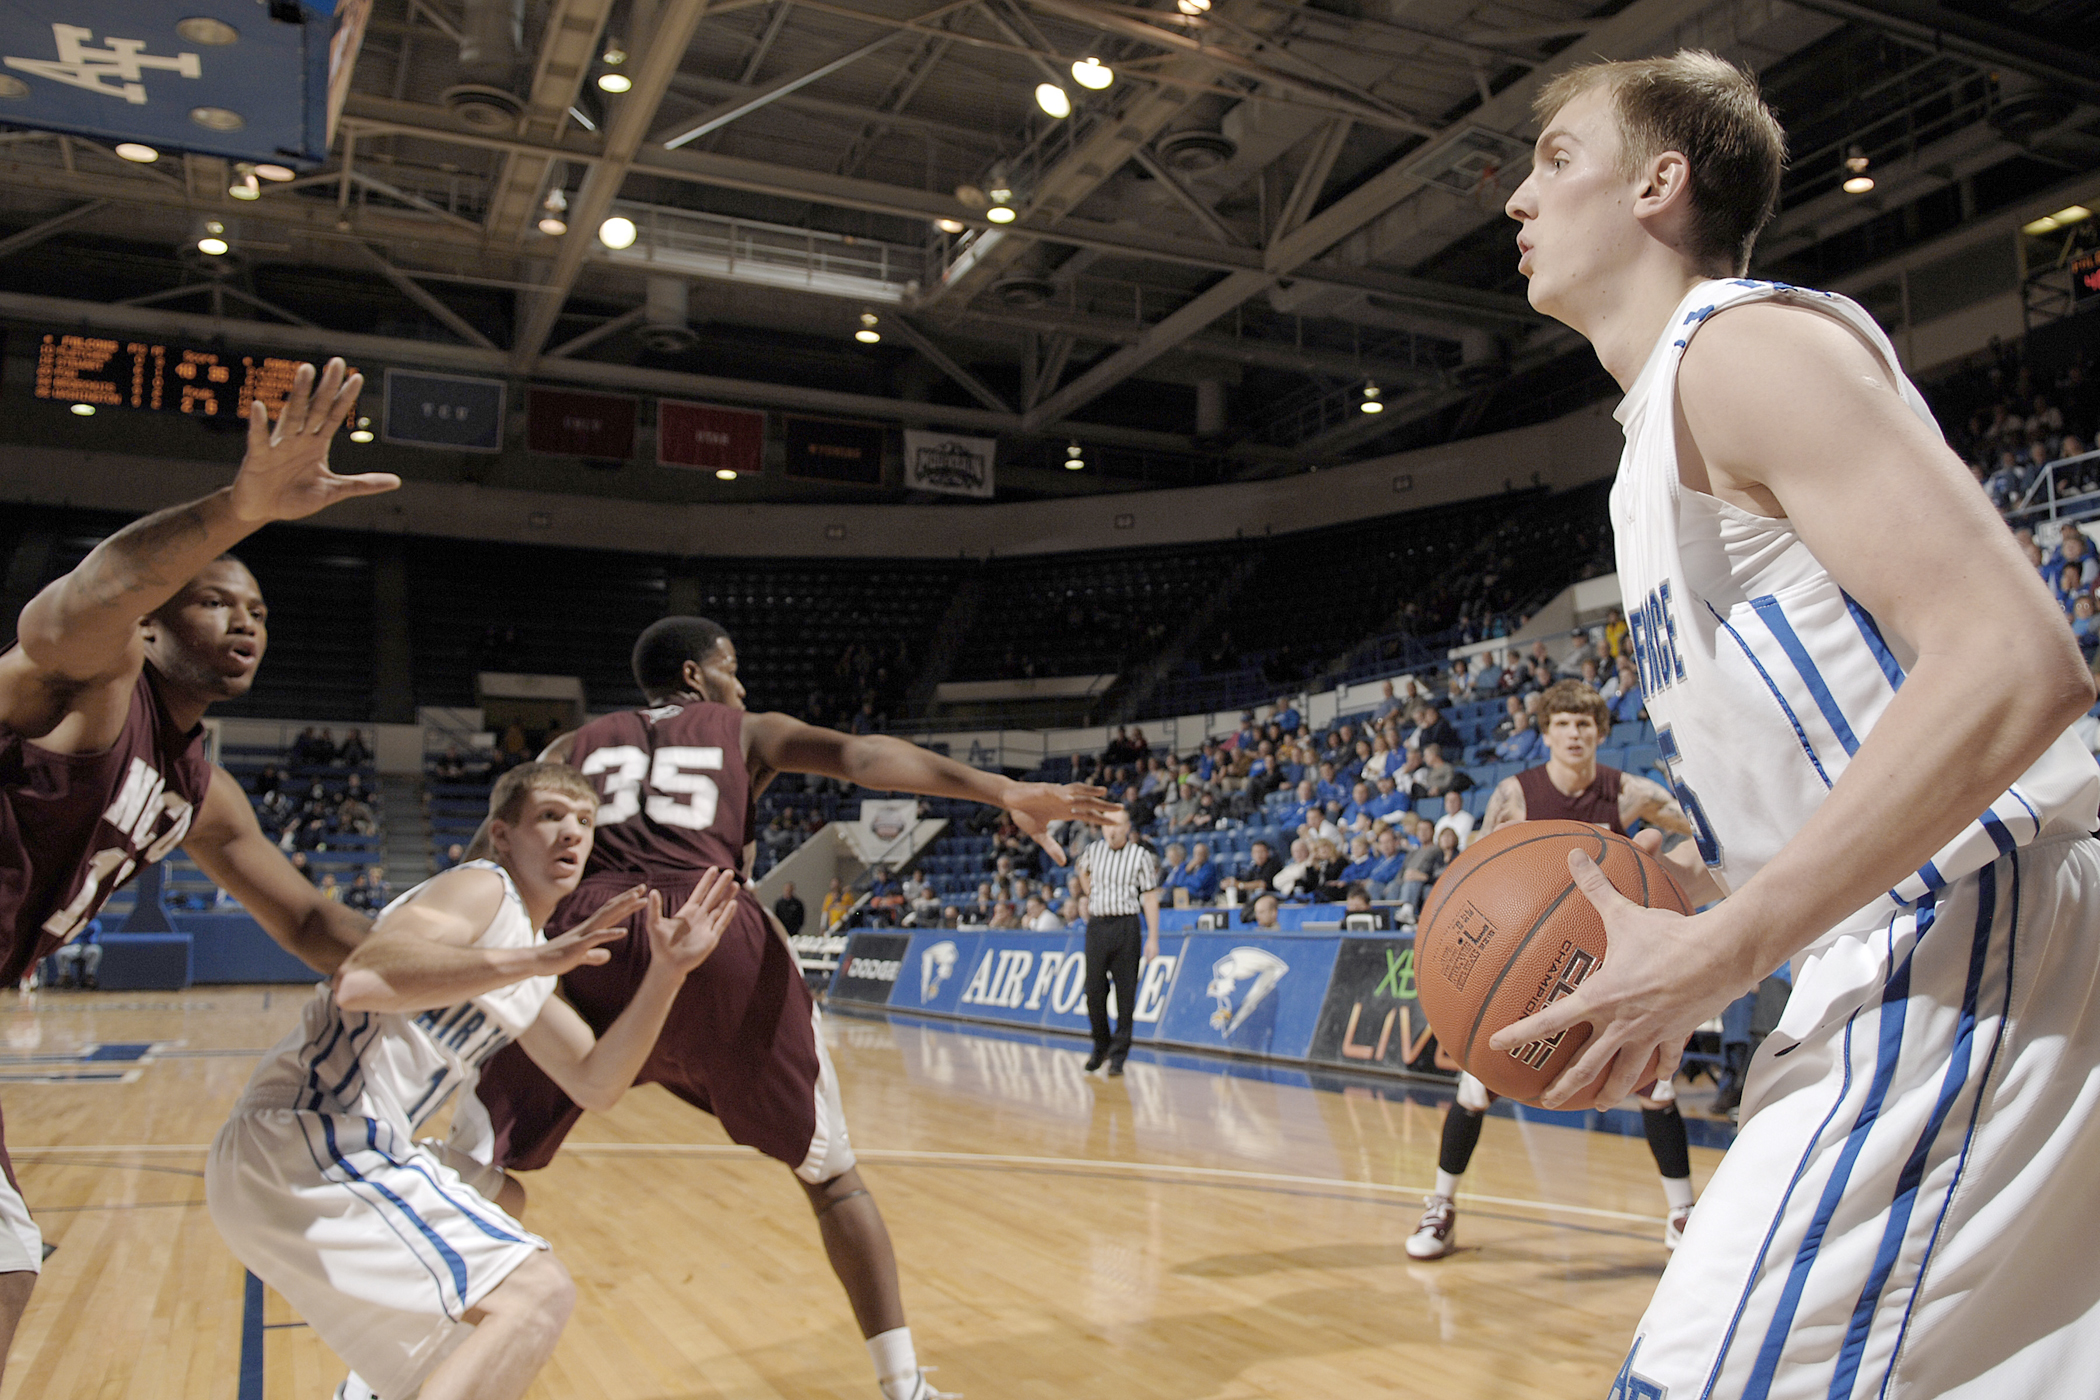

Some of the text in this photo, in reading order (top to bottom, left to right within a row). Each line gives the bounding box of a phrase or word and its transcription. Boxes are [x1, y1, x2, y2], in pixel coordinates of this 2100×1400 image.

[421, 401, 469, 422] TCU
[581, 745, 723, 830] 35
[847, 957, 902, 982] DODGE
[961, 948, 1177, 1023] AIR FOE
